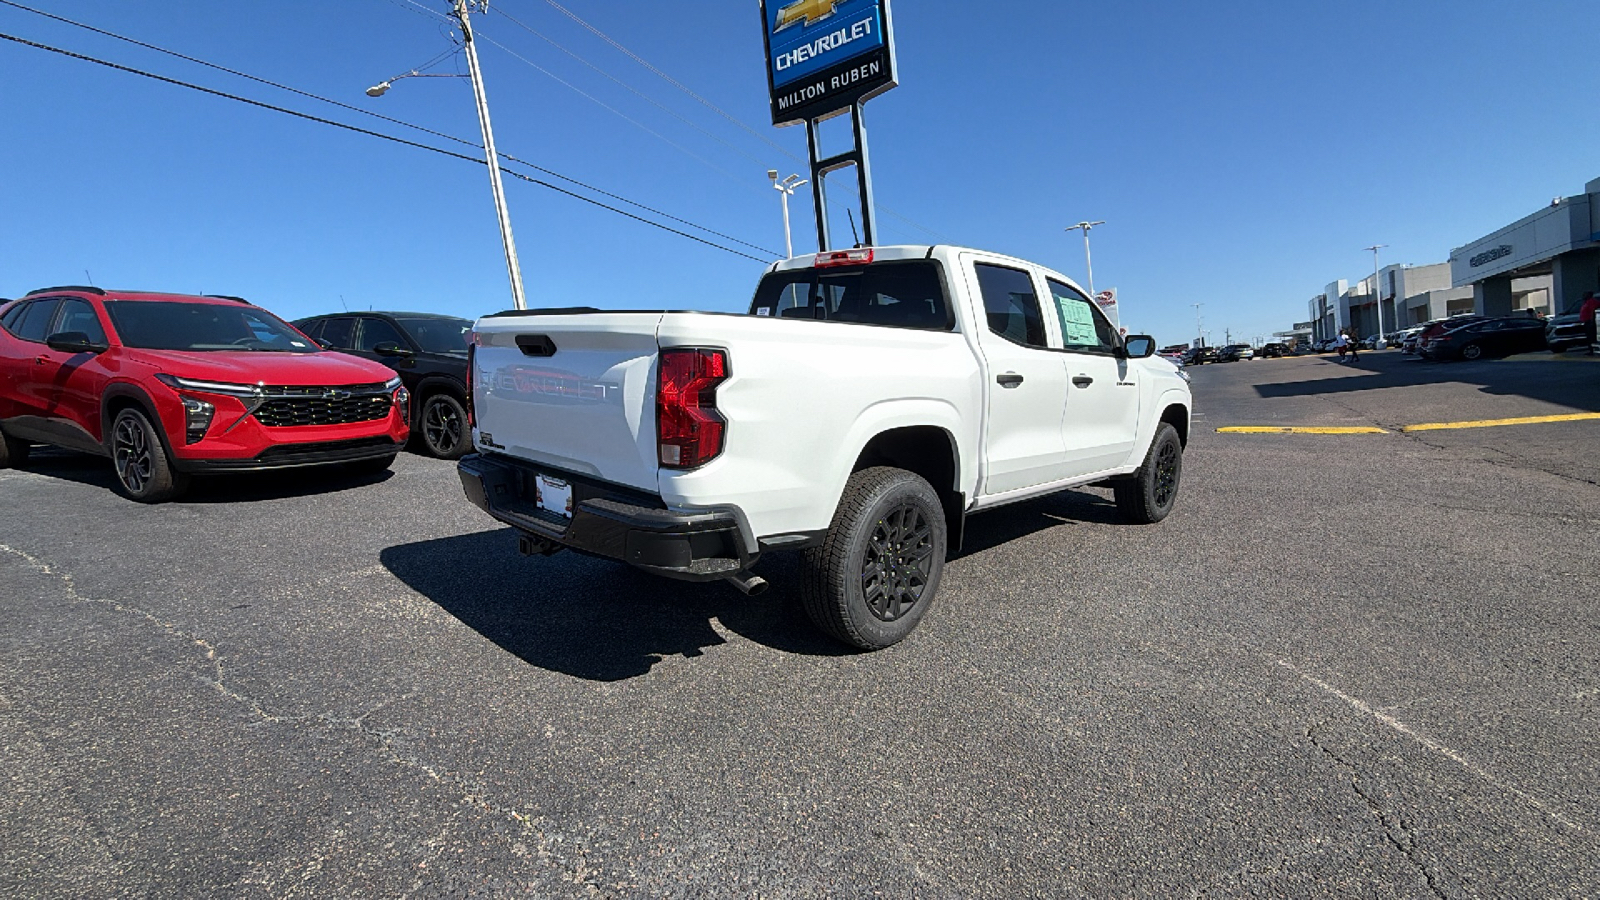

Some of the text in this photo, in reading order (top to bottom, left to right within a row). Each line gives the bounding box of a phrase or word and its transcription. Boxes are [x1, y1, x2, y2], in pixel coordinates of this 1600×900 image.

[776, 17, 872, 71] CHEVROLET
[778, 60, 879, 110] MILTON RUBEN
